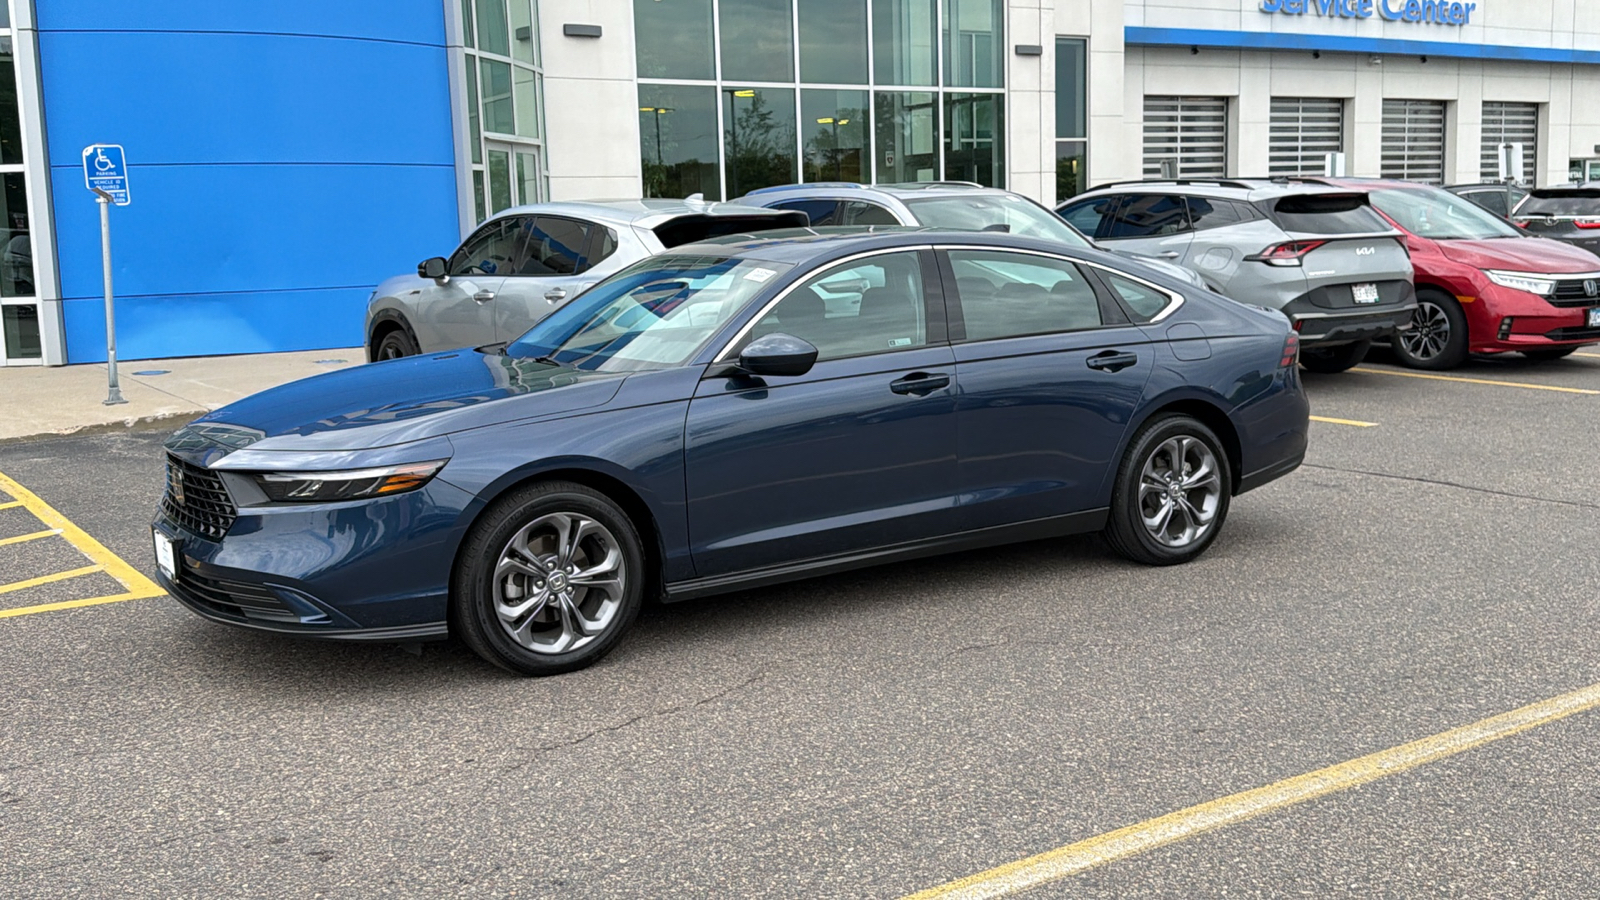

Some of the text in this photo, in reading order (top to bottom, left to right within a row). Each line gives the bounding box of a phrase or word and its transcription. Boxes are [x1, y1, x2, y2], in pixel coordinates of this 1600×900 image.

[1260, 0, 1476, 24] Service Center
[1356, 247, 1375, 255] KIA
